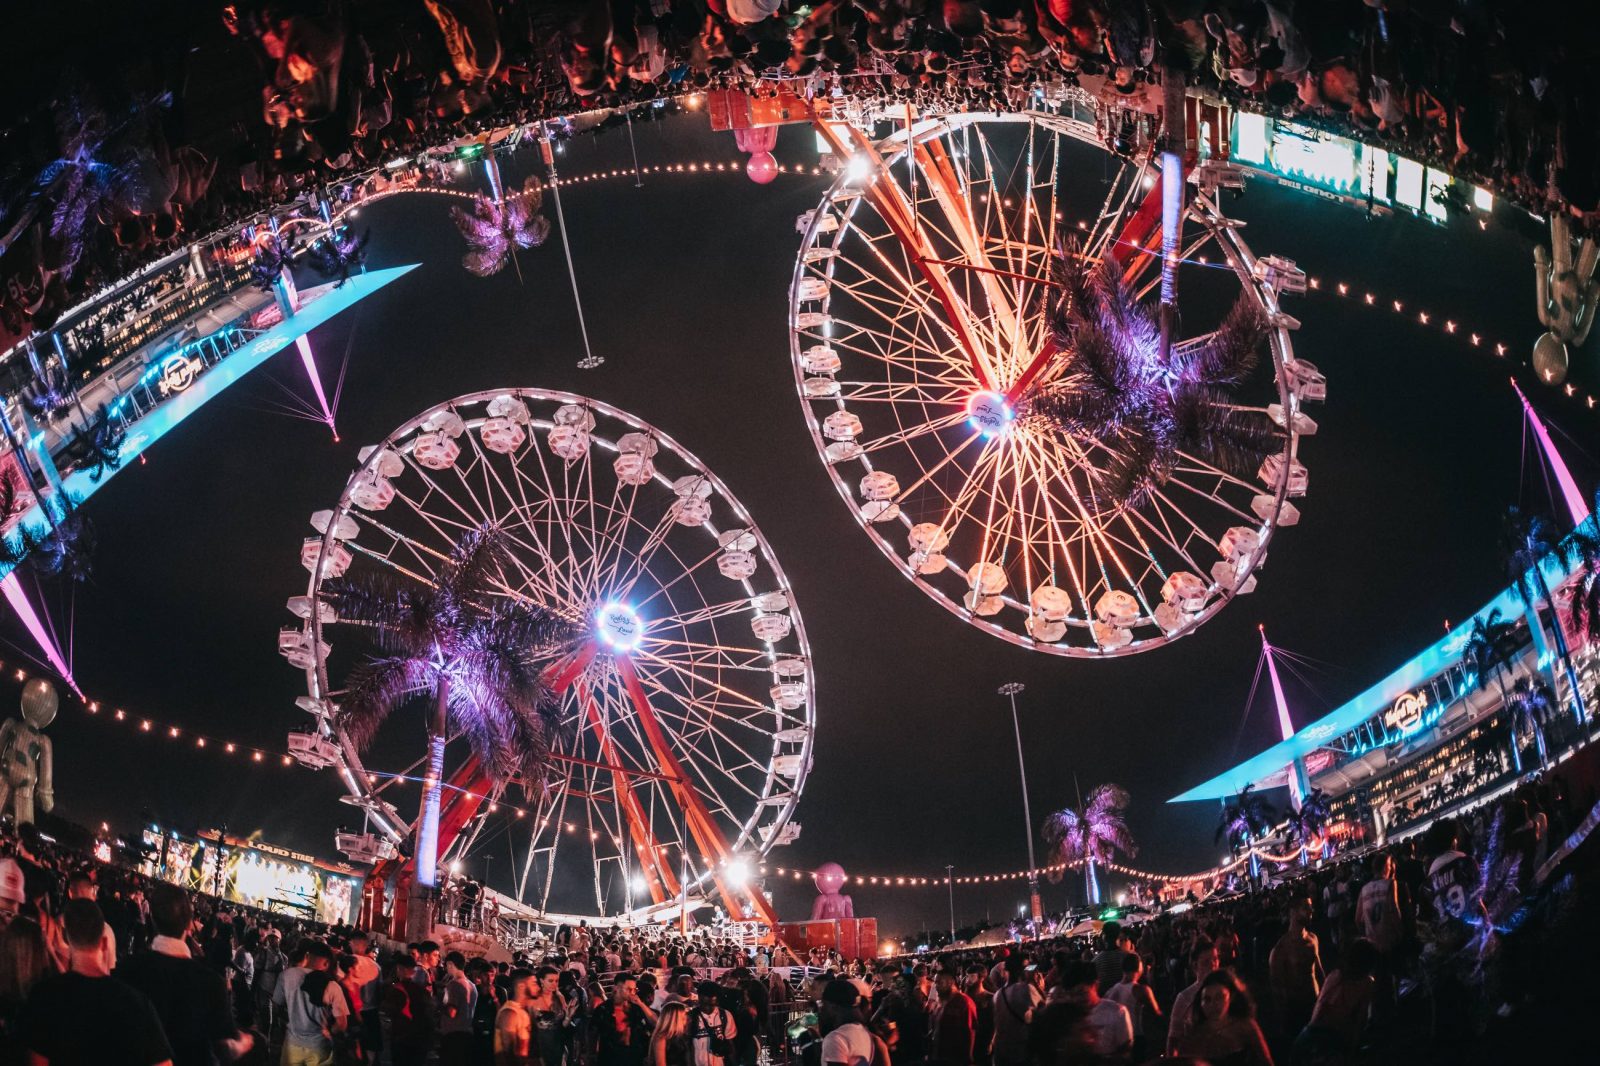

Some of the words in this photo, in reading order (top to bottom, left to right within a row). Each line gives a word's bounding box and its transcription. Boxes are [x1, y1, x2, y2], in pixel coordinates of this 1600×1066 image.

[1277, 177, 1302, 191] STAGE
[1303, 184, 1344, 203] LOUD
[249, 840, 289, 858] LOUD
[290, 850, 316, 864] STAGE
